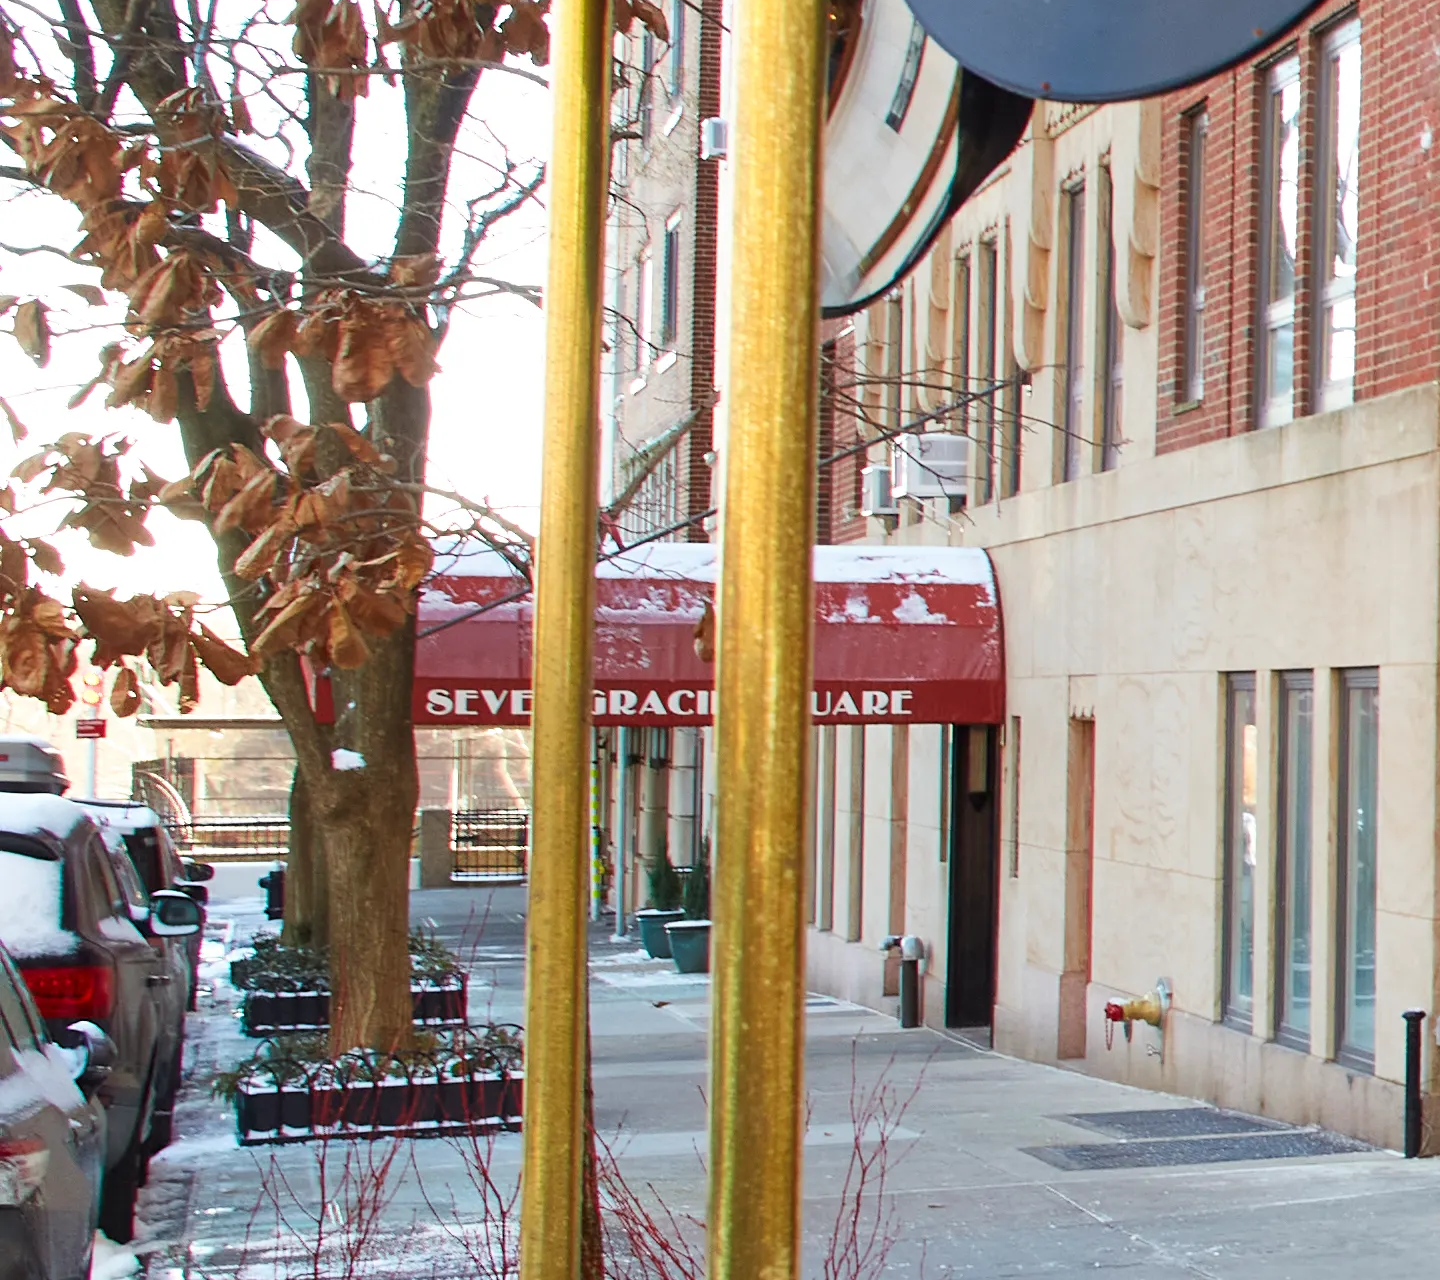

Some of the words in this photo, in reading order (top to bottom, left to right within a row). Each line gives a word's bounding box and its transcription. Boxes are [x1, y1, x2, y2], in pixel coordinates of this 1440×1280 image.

[425, 688, 534, 716] SEVE
[591, 689, 718, 716] RACI
[808, 689, 914, 716] UARE
